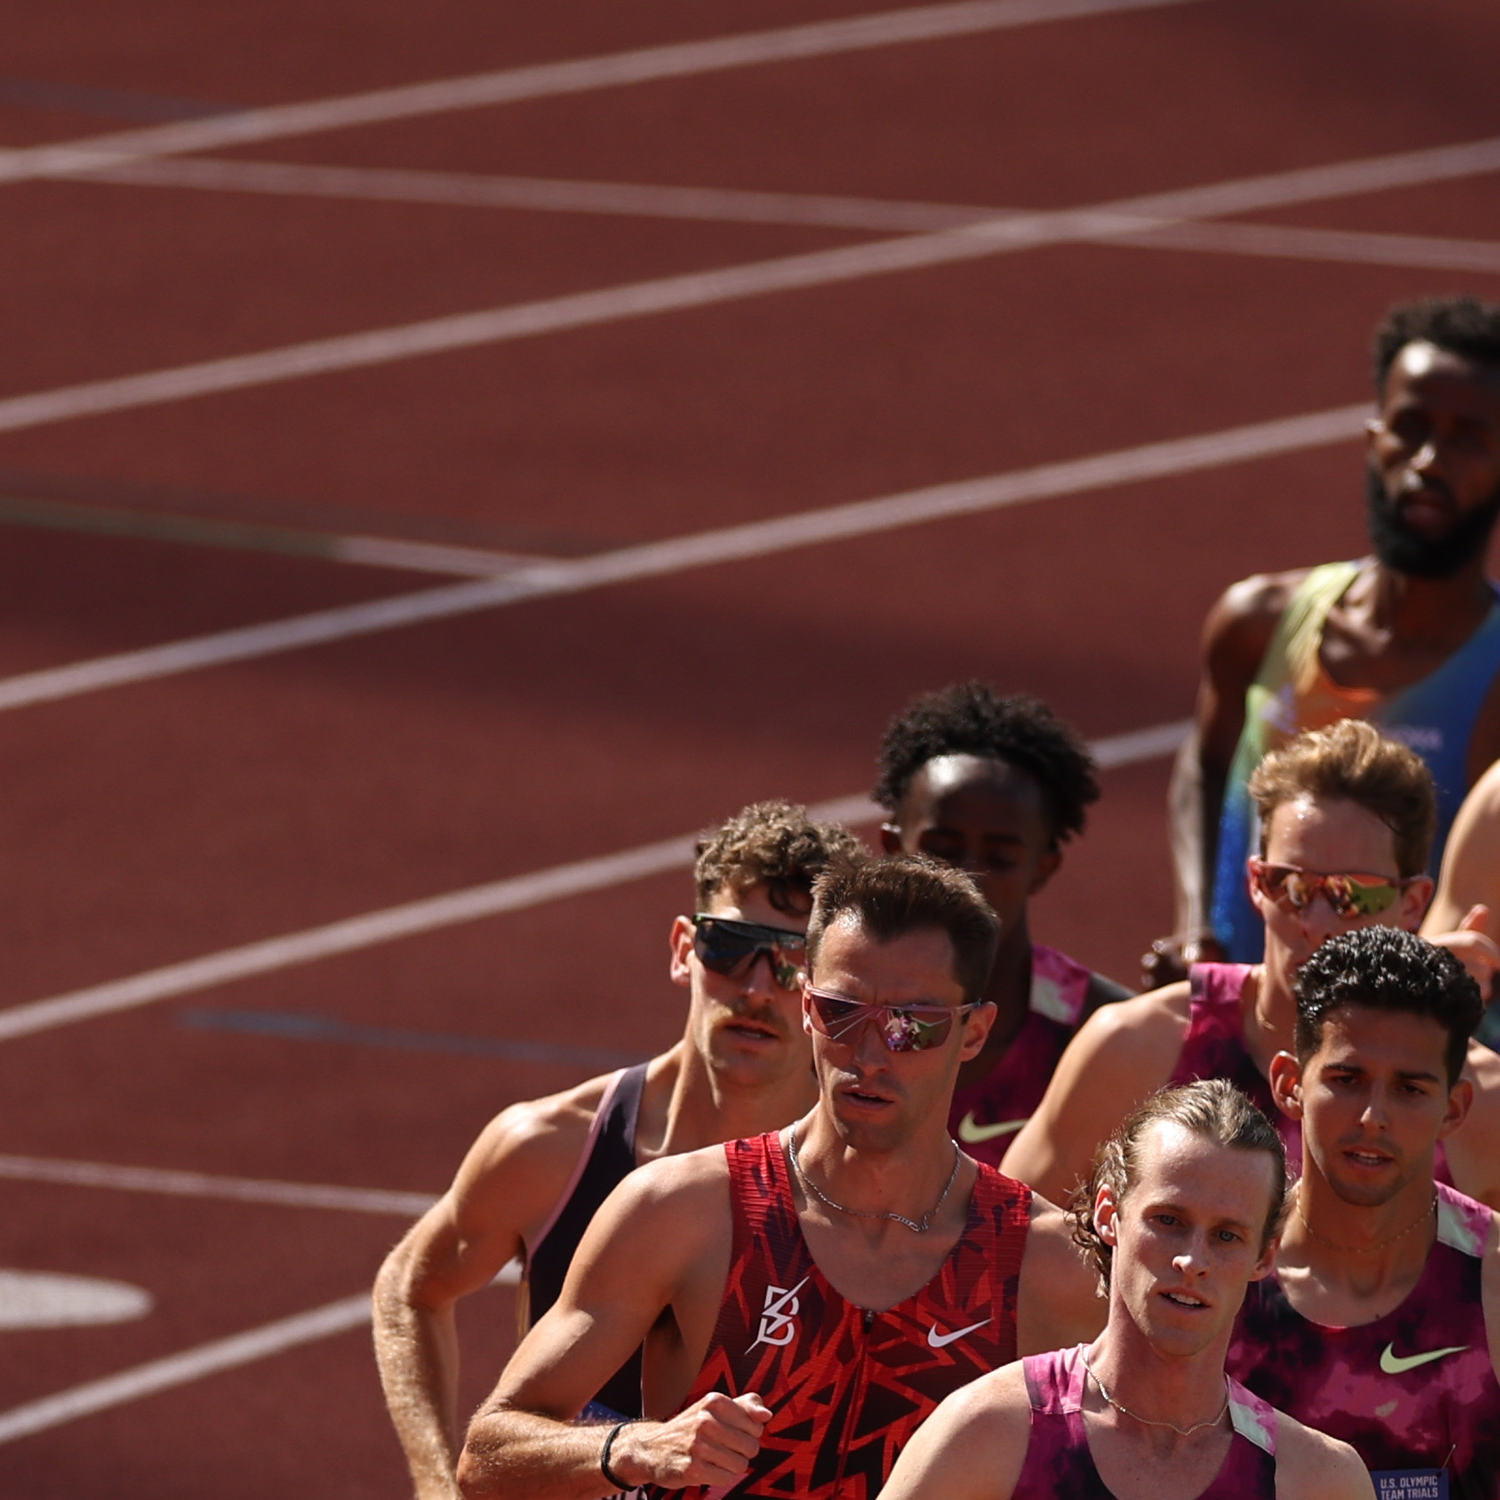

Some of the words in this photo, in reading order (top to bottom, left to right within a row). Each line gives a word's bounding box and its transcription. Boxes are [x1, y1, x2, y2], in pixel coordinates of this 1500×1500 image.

[1380, 1477, 1397, 1489] U.S.
[1399, 1475, 1438, 1488] OLYMPIC
[1381, 1489, 1405, 1500] TEAM
[1407, 1487, 1438, 1499] TRIALS
